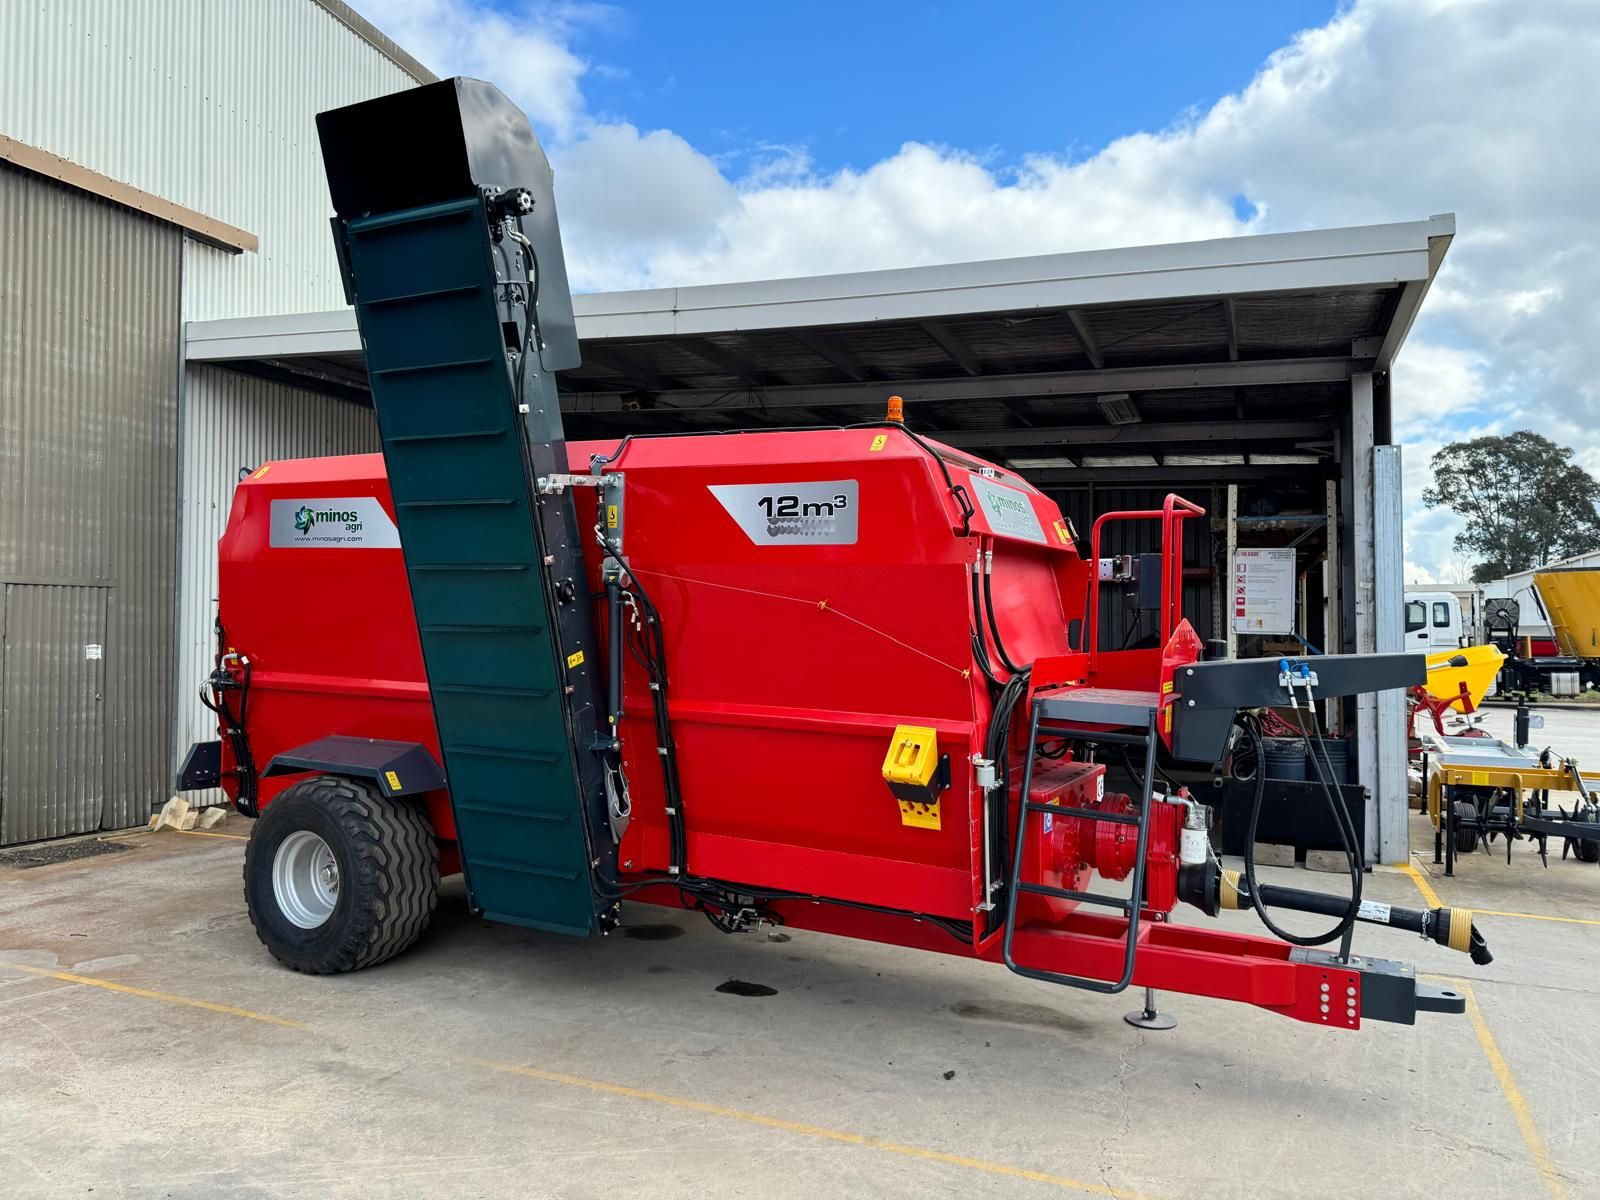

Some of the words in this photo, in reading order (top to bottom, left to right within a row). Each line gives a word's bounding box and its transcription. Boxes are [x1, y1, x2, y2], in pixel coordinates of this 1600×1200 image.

[997, 495, 1026, 513] minos
[316, 507, 358, 522] minos
[345, 521, 363, 533] agri
[294, 535, 363, 543] www.minosagri.com
